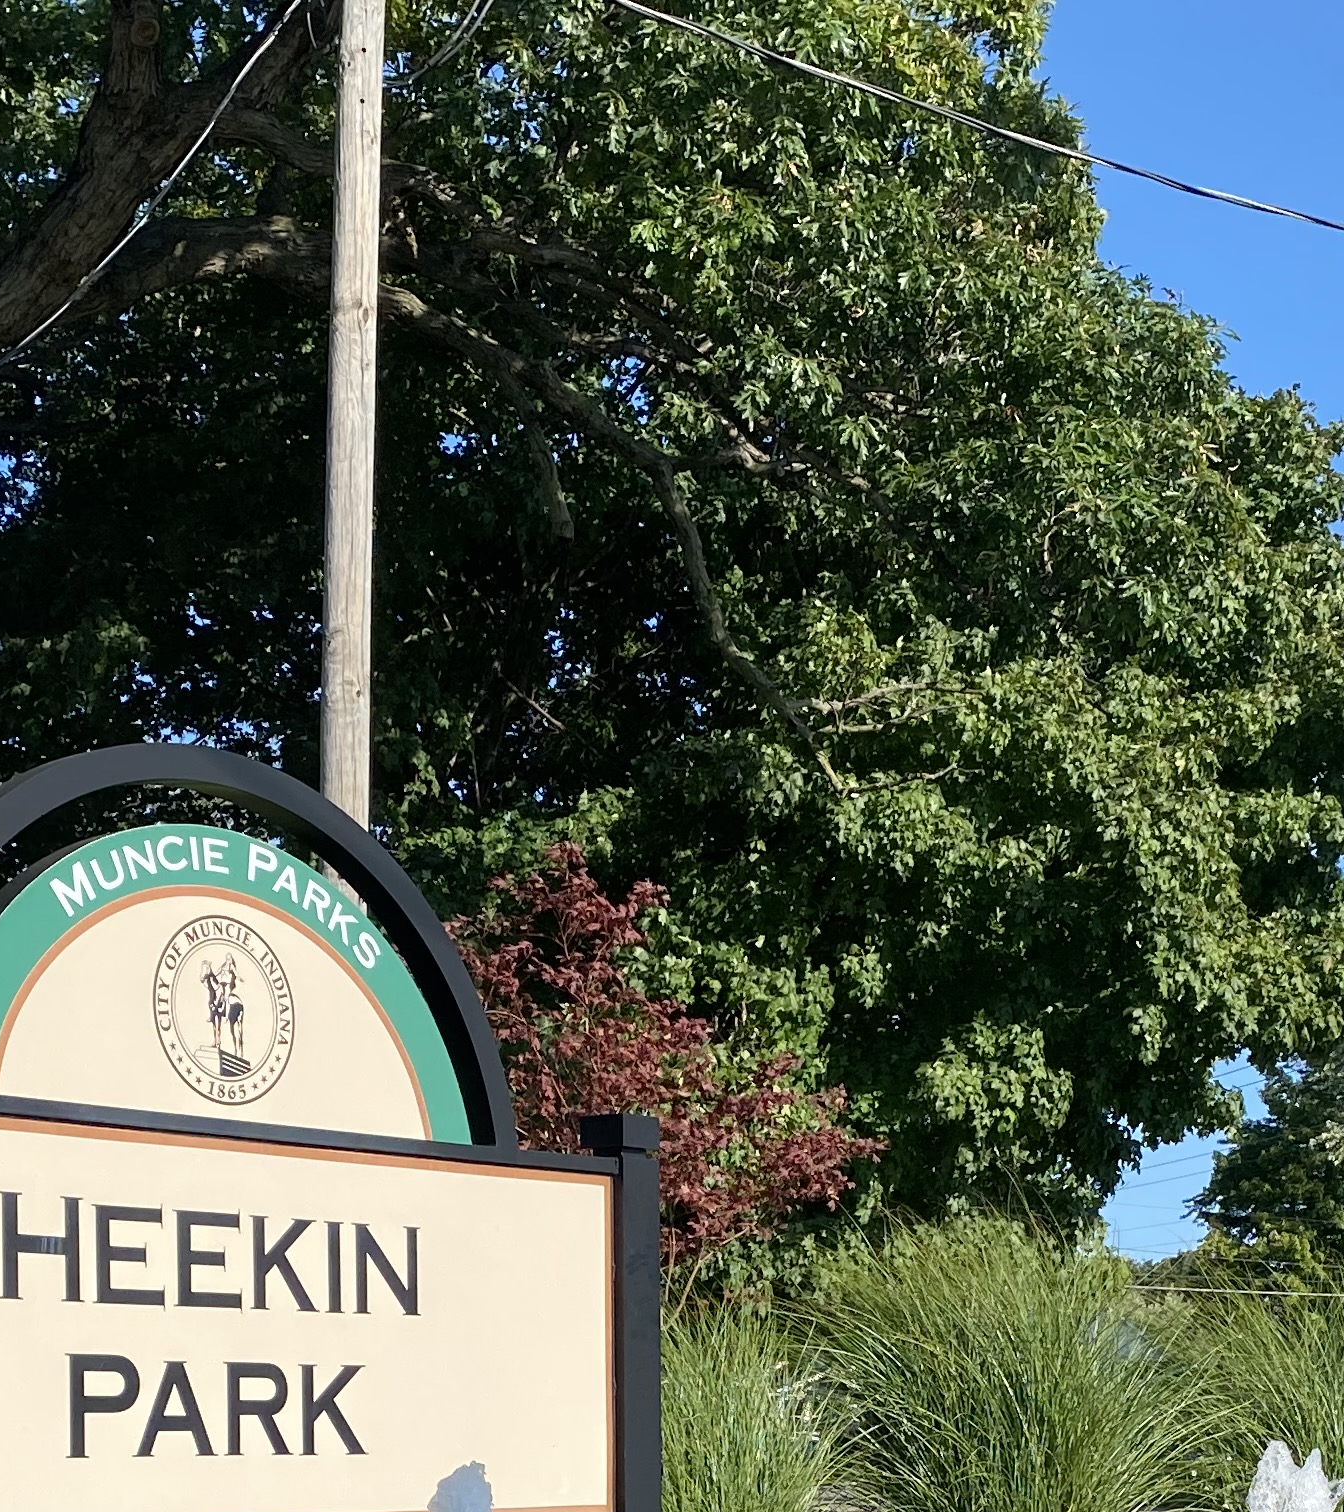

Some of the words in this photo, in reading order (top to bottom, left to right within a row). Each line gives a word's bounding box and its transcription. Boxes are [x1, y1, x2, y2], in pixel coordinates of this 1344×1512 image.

[49, 835, 230, 918] MUNCIE
[247, 843, 382, 970] PARKS
[164, 942, 183, 971] OF
[184, 920, 255, 952] MUNCIE,
[158, 977, 171, 1032] CITY
[259, 951, 291, 1046] INDIANA
[207, 1081, 247, 1100] 1865
[65, 1353, 369, 1459] PARK
